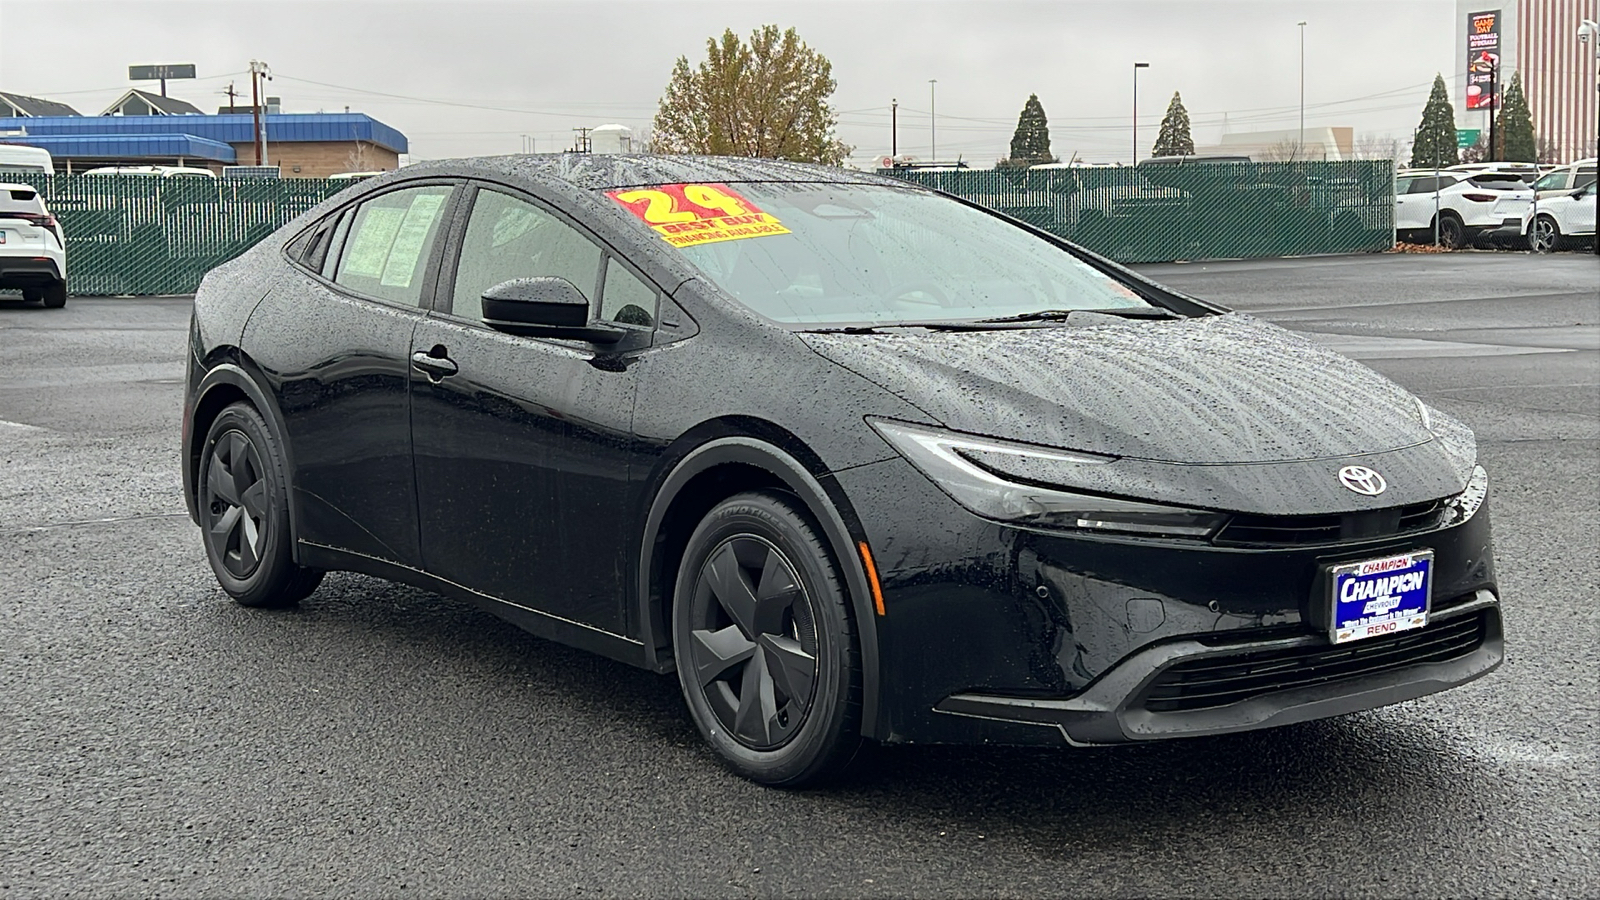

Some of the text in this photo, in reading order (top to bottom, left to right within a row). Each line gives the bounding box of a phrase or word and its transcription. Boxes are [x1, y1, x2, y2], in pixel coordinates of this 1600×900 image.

[1474, 19, 1494, 27] GAME
[616, 185, 748, 223] 24
[662, 214, 766, 233] BEST BUY
[667, 224, 784, 245] FINANCING AVAILABLE
[718, 506, 749, 519] TOYO
[1362, 558, 1409, 574] CHAMPION
[1340, 571, 1424, 603] CHAMPION
[1367, 599, 1398, 611] CHEVROLET
[1367, 622, 1397, 635] RENO
